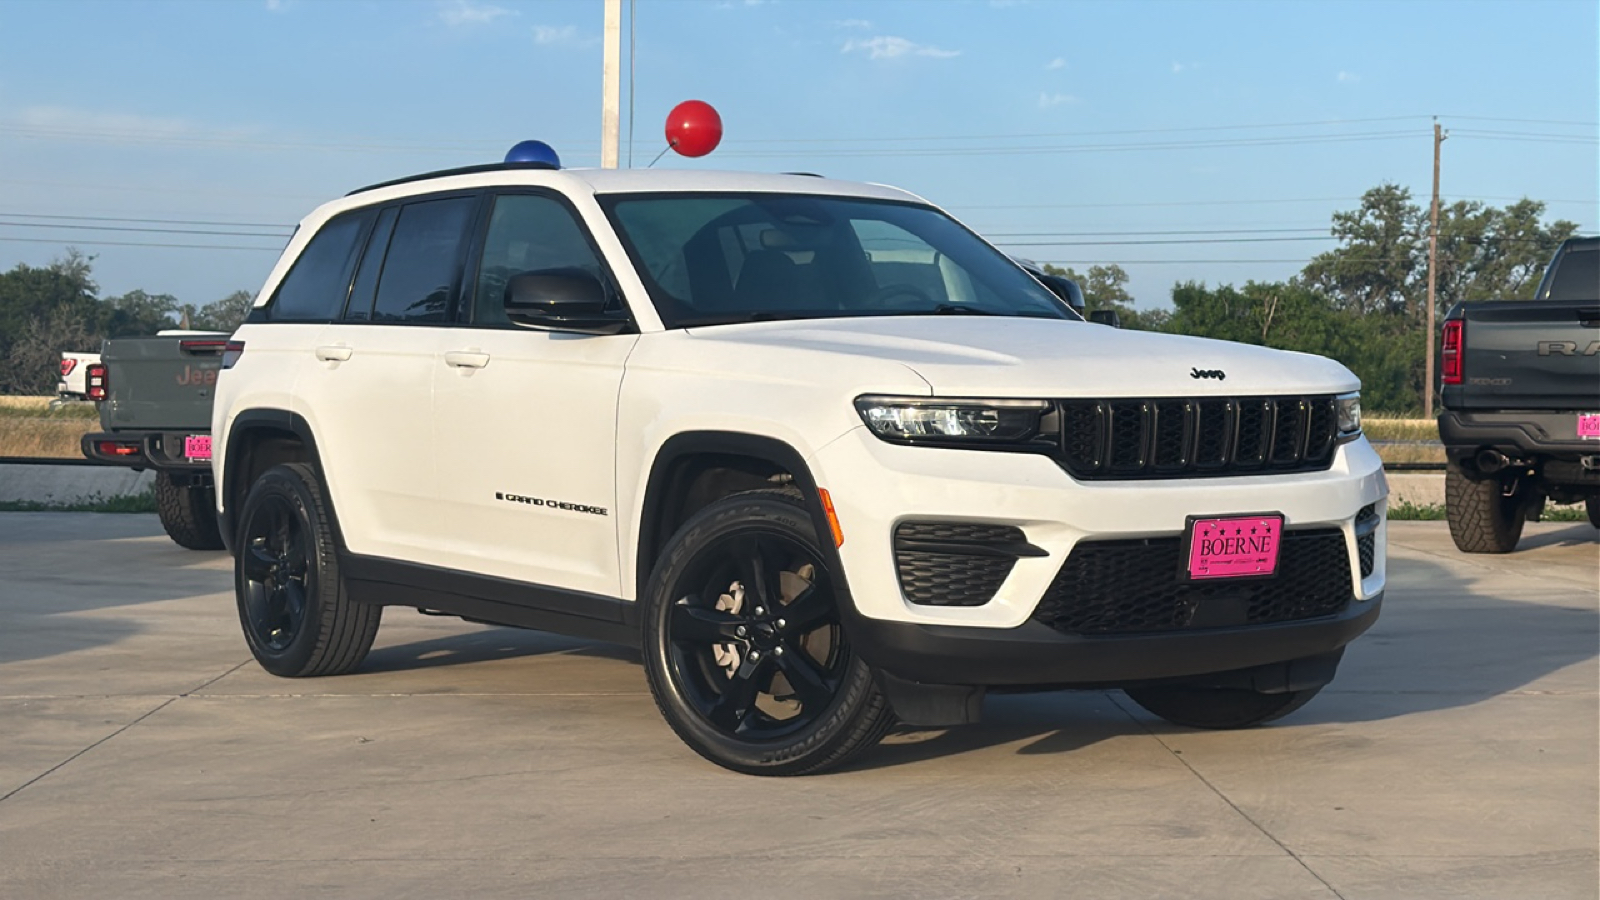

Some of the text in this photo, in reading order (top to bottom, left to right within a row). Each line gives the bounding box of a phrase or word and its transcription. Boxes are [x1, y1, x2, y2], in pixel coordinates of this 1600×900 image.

[1189, 367, 1226, 381] Jeep
[505, 493, 608, 516] GRAND CHEROKEE
[1200, 536, 1271, 556] BOERNE
